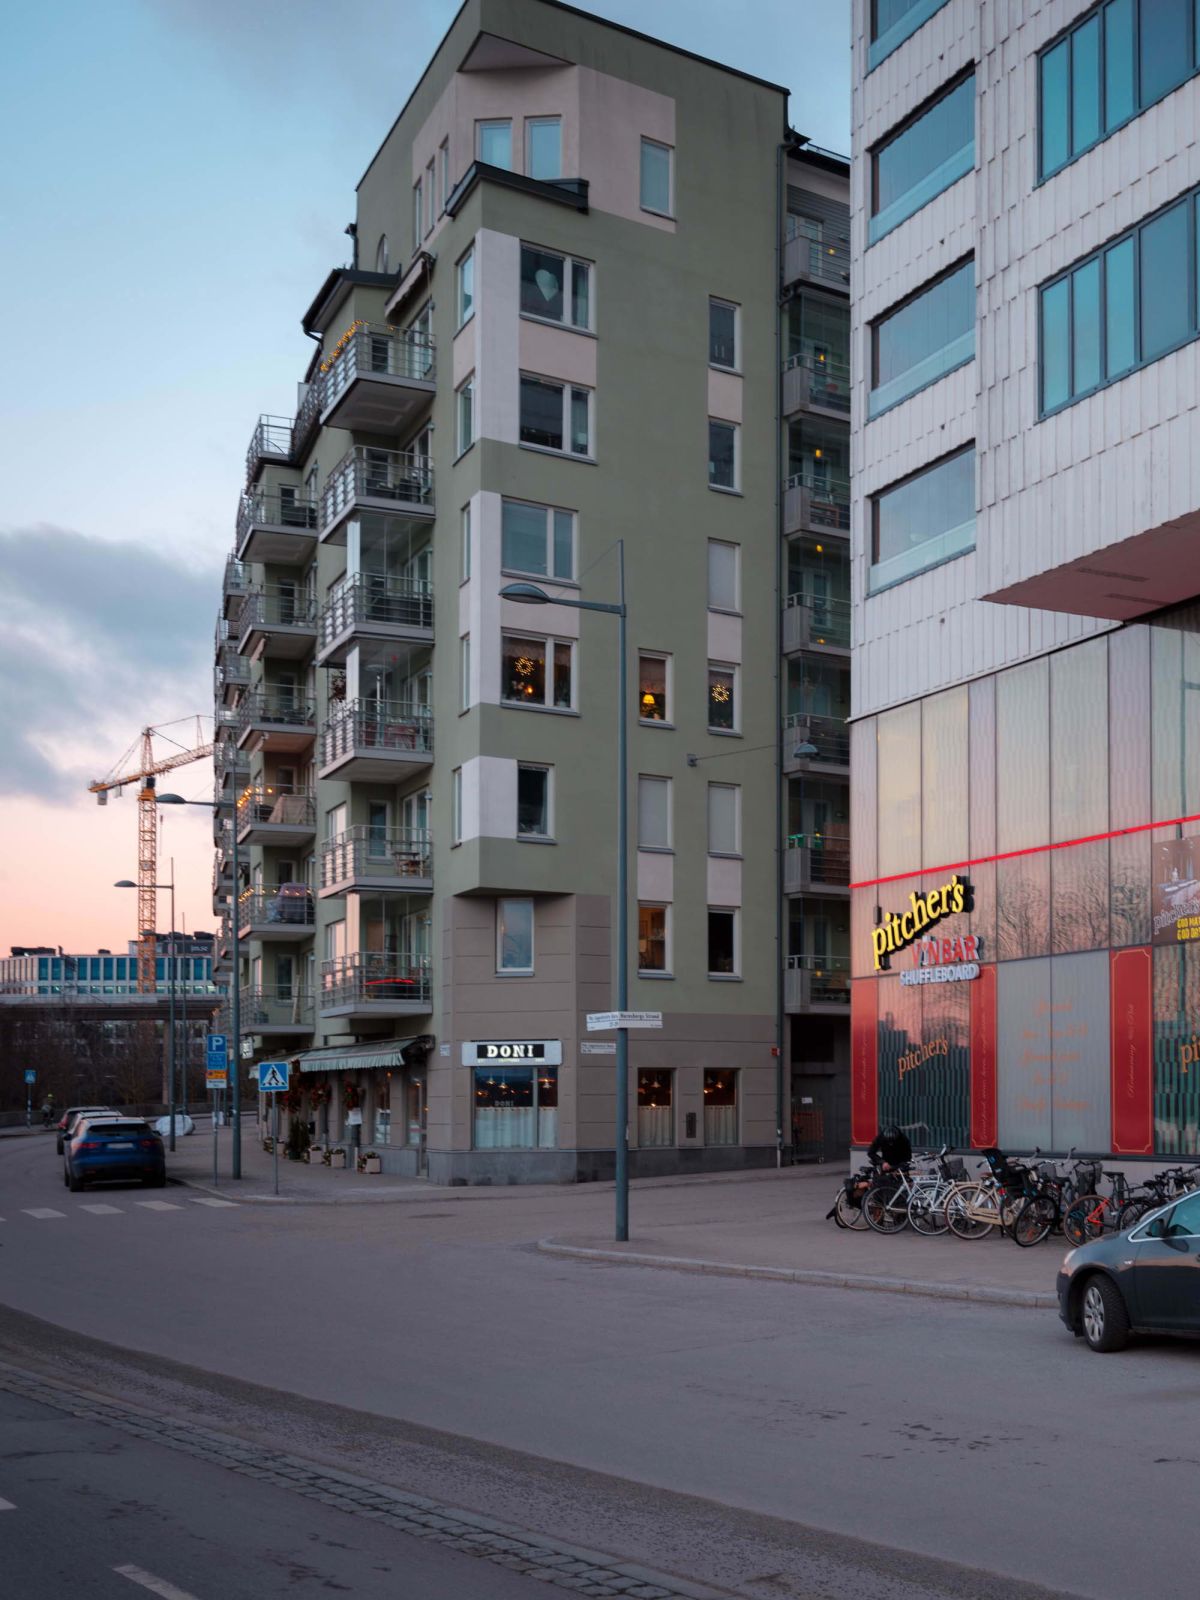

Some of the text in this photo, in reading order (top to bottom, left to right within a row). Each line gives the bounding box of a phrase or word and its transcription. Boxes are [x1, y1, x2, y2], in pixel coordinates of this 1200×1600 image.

[871, 875, 965, 971] pitcher's
[901, 964, 980, 985] SHUFFLEBOARD
[487, 1045, 534, 1058] DONI
[897, 1035, 949, 1080] pitcher's
